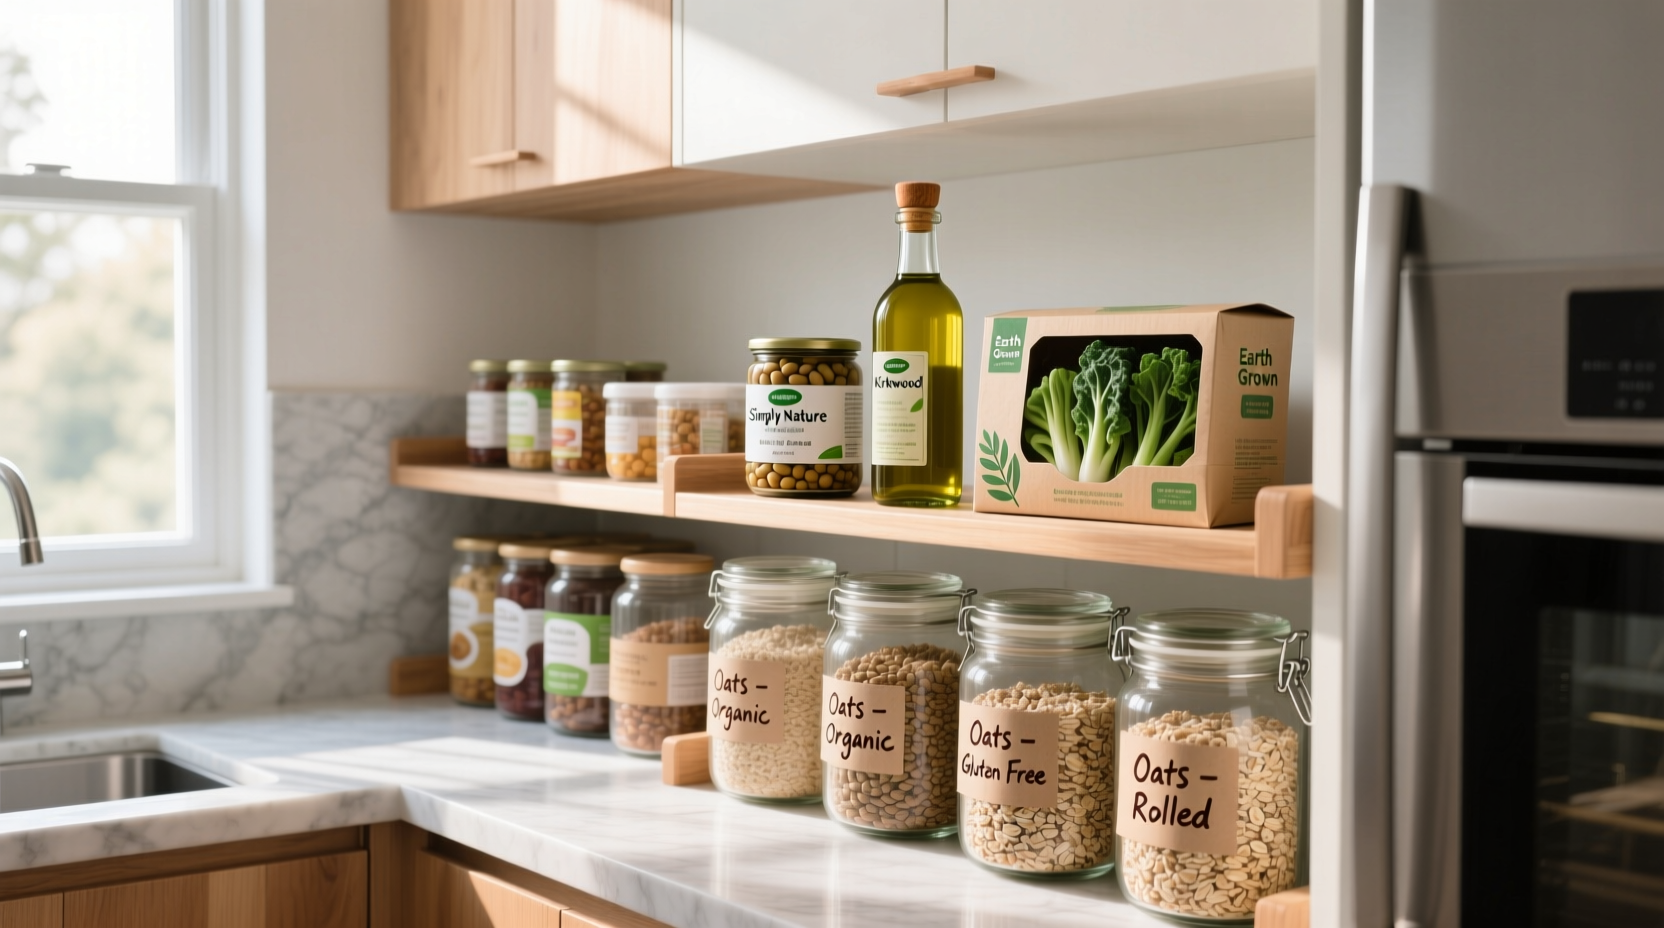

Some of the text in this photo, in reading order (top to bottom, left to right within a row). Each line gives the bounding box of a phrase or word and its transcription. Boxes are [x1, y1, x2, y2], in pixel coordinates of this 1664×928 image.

[1239, 347, 1273, 366] Earth
[1237, 368, 1278, 387] Grown
[749, 407, 828, 426] Simply Nature
[714, 668, 748, 695] Oats
[711, 697, 771, 731] Organic
[828, 692, 864, 719] Oats
[825, 722, 895, 760] Organic
[969, 719, 1012, 750] Oats
[1006, 758, 1047, 785] Free
[1133, 752, 1189, 789] Oats
[1132, 791, 1212, 830] Rolled
